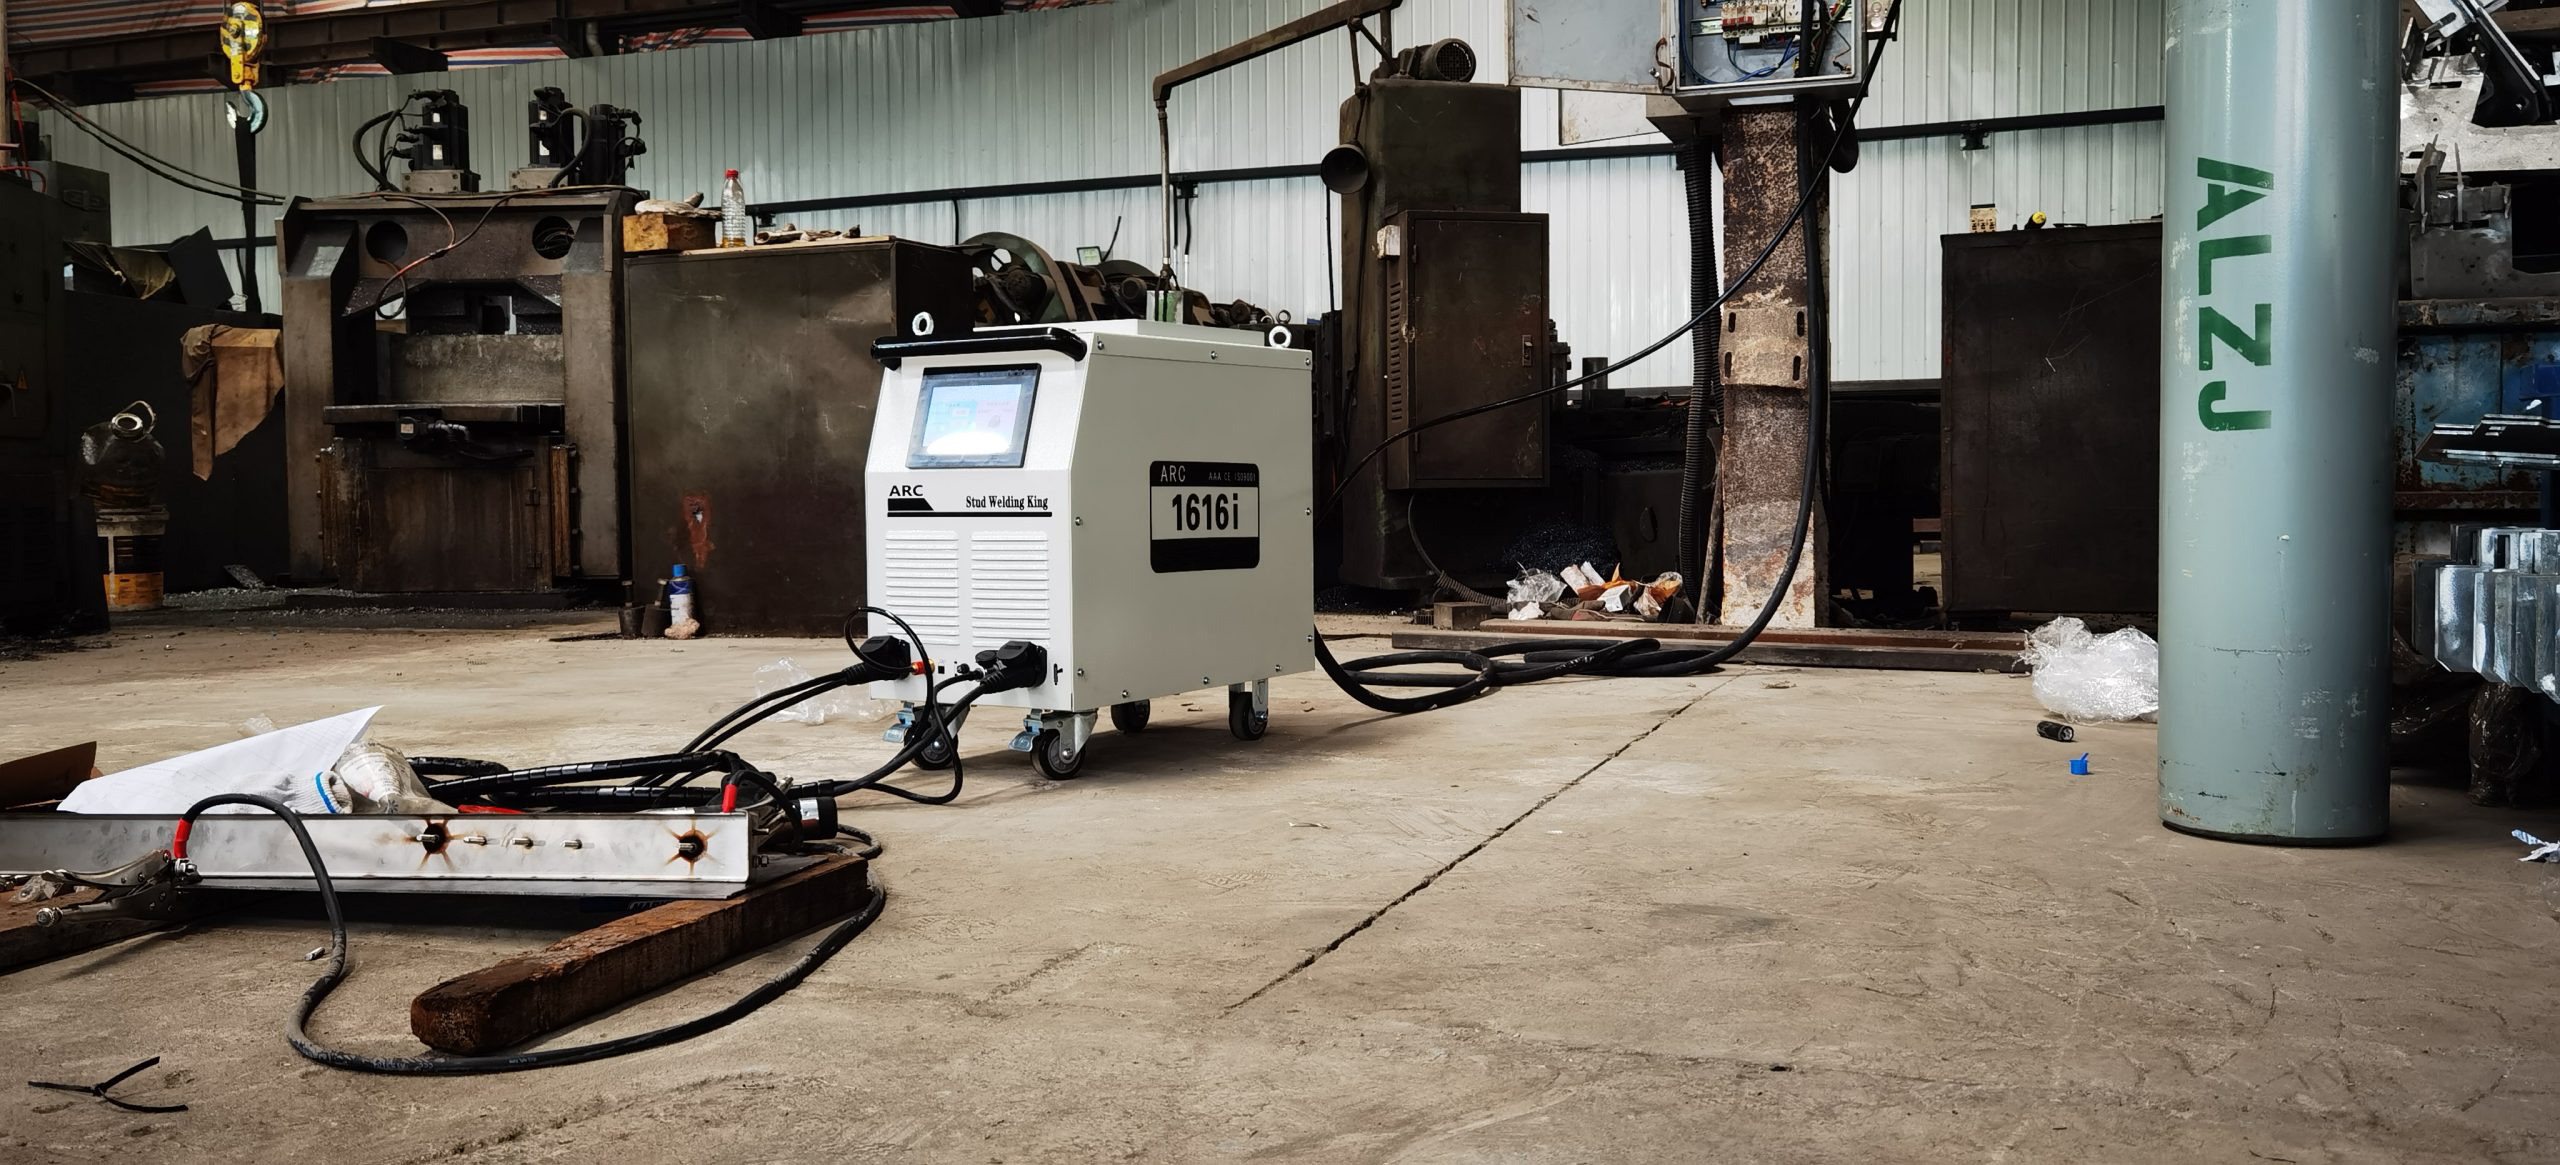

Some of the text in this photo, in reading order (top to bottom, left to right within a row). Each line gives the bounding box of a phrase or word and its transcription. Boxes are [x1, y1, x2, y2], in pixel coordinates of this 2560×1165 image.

[2197, 157, 2274, 431] ALZJ
[1160, 465, 1186, 482] ARC
[1208, 472, 1221, 481] AAA
[1224, 472, 1231, 481] CE
[889, 485, 924, 497] ARC
[966, 495, 1048, 510] Stud Welding King
[1172, 493, 1238, 531] 1616i
